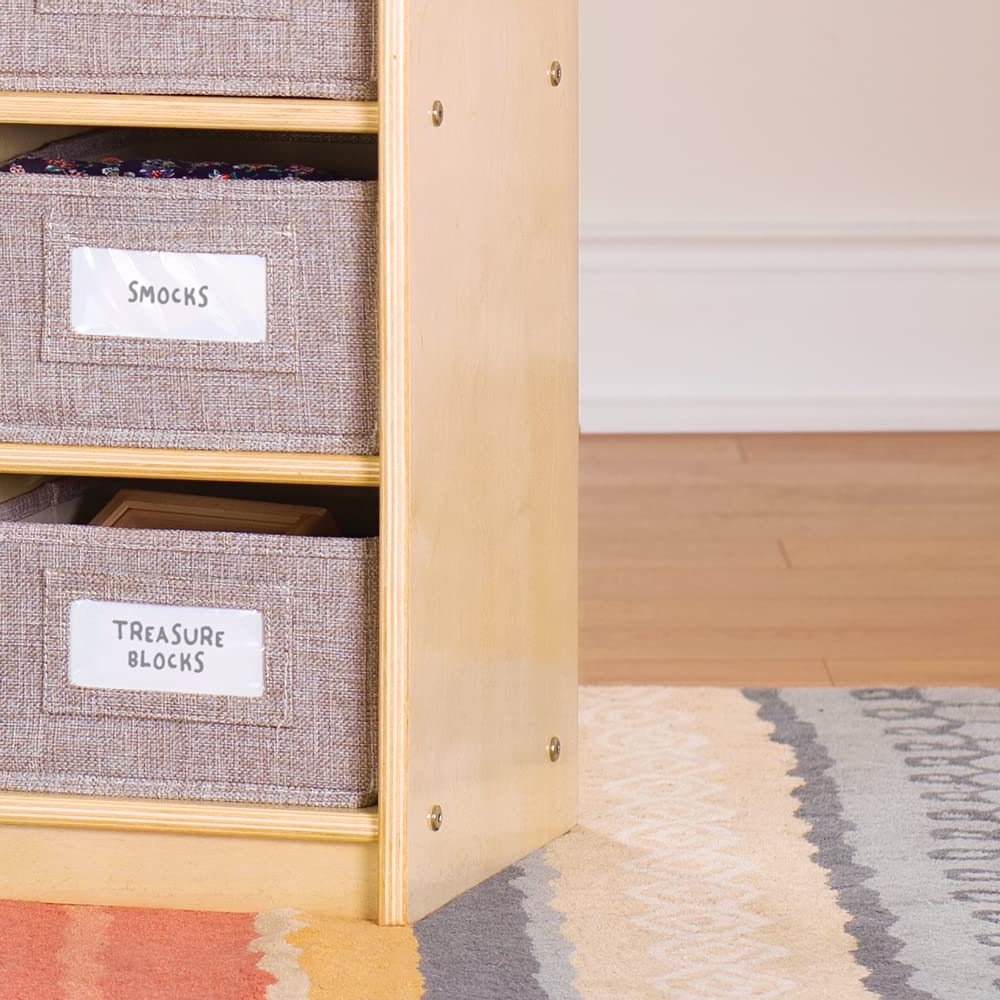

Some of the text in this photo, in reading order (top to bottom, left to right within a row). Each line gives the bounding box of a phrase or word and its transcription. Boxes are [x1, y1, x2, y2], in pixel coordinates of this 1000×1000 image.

[128, 280, 209, 308] SMOCKS
[112, 620, 225, 648] TREASURE
[128, 650, 204, 673] BLOCKS
